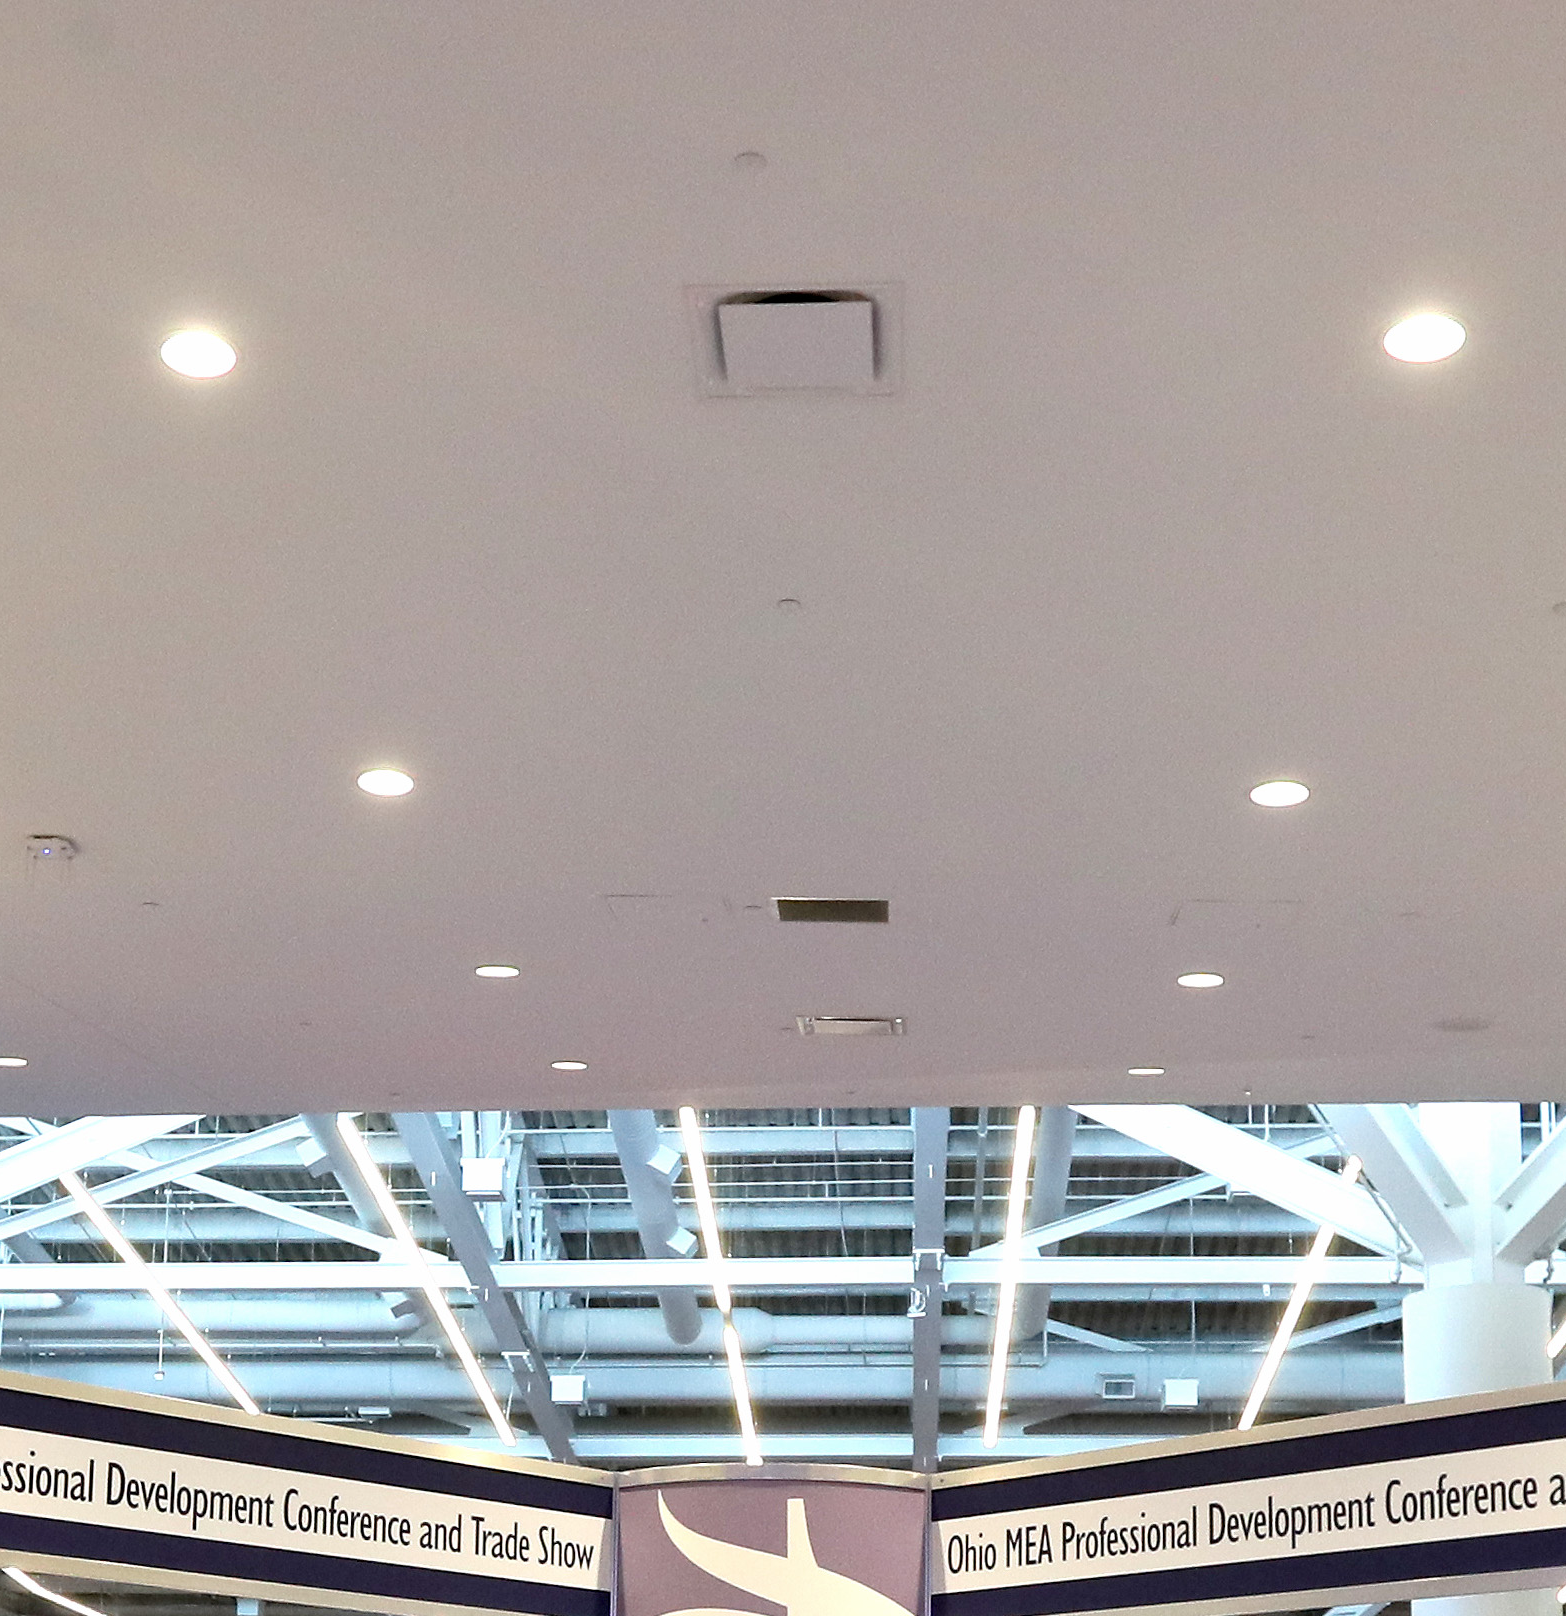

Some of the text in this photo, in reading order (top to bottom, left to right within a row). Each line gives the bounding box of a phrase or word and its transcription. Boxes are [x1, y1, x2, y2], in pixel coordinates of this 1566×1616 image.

[106, 1461, 274, 1530] Development
[283, 1488, 411, 1546] Conference
[419, 1514, 462, 1553] and
[471, 1515, 530, 1562] Trade
[538, 1525, 595, 1570] Show
[947, 1532, 997, 1574] Ohio
[1006, 1524, 1053, 1568] MEA
[1061, 1505, 1197, 1562] Professional
[1208, 1491, 1375, 1548] Development
[1385, 1473, 1537, 1524] Conference
